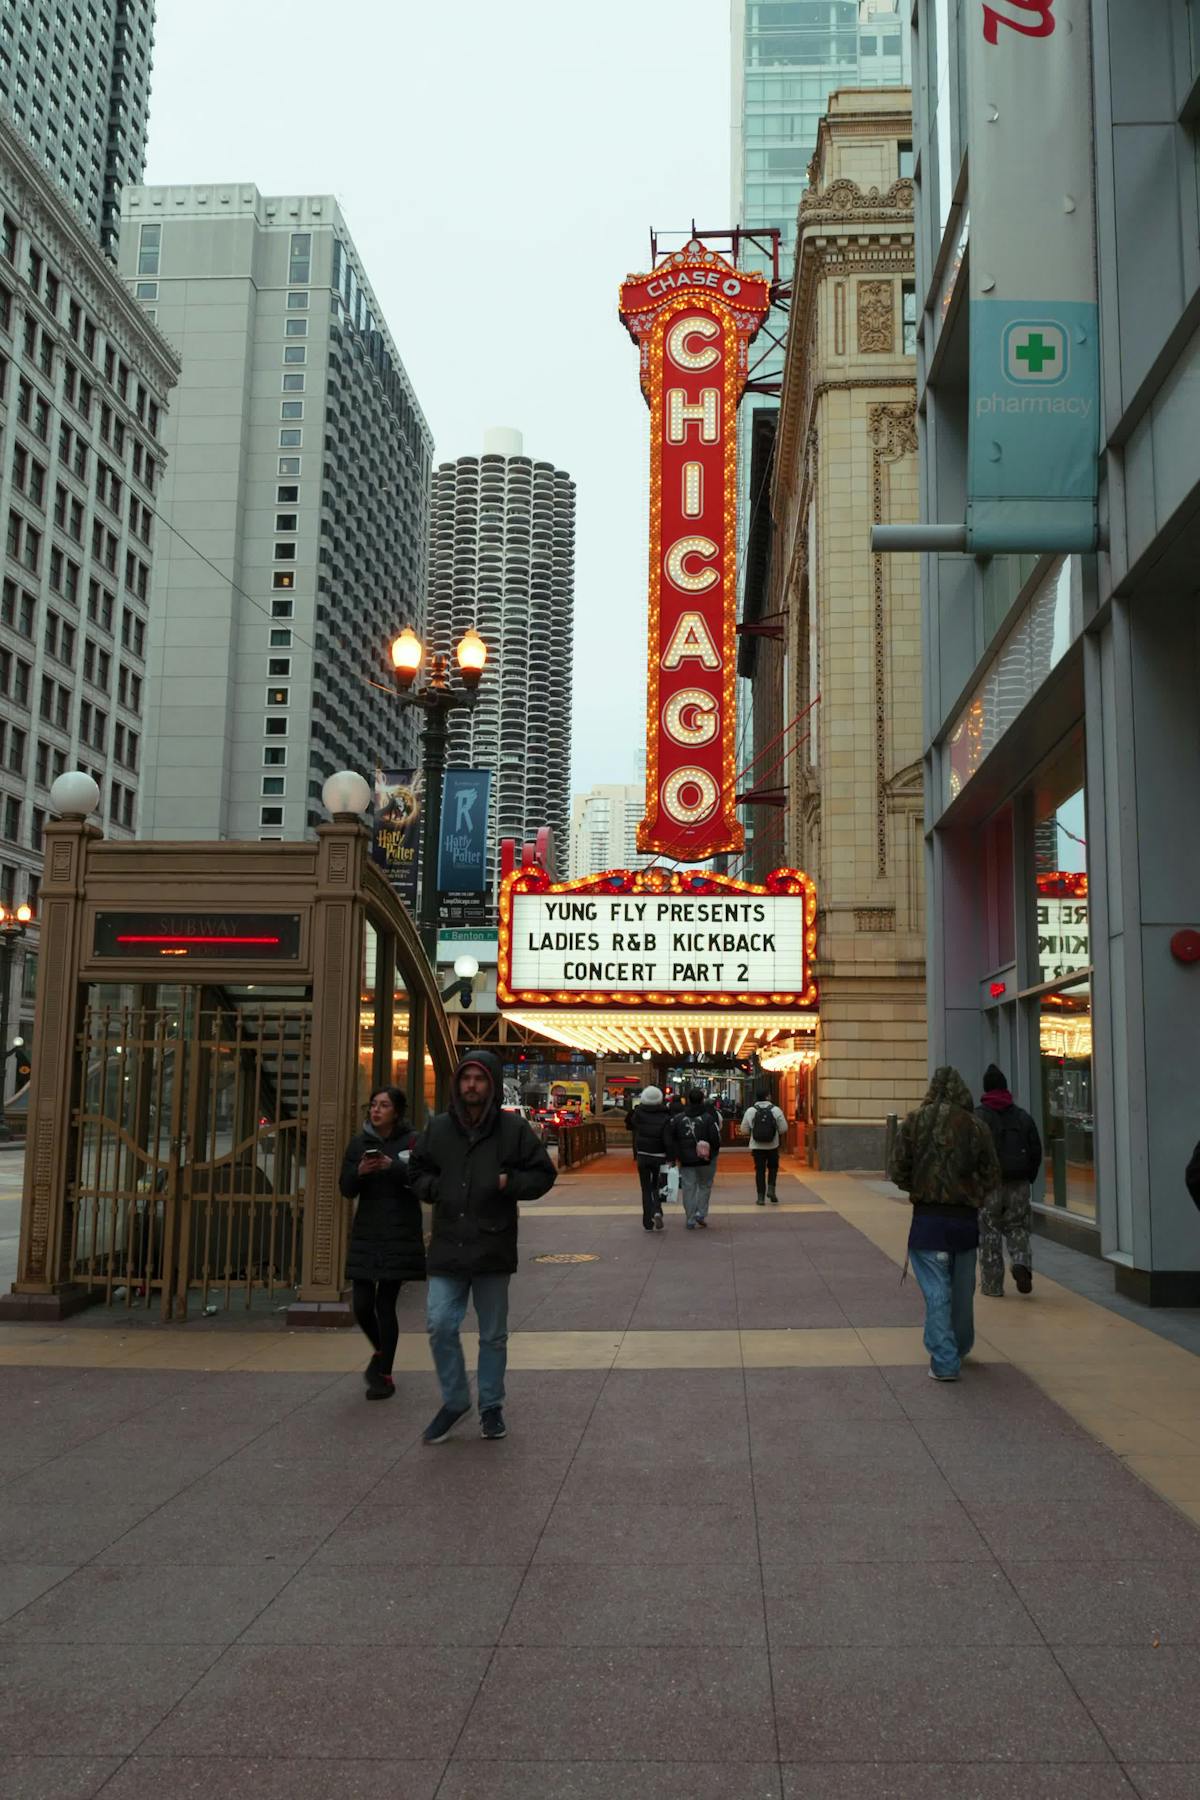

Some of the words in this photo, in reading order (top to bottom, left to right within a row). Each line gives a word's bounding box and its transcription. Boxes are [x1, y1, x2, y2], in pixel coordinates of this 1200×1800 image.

[646, 271, 721, 298] CHASE
[976, 392, 1092, 418] pharmacy
[660, 316, 722, 827] CHICAGO
[376, 829, 406, 848] Harry
[444, 834, 472, 852] Harry
[386, 845, 415, 864] Potter
[453, 848, 481, 864] Potter
[545, 902, 598, 921] YUNG
[610, 903, 647, 921] FLY
[657, 904, 765, 923] PRESENTS
[160, 917, 241, 936] SUBWAY
[451, 931, 484, 940] Benton
[529, 932, 599, 951] LADIES
[612, 933, 657, 951] R&B
[673, 933, 776, 953] KICKBACK
[563, 962, 657, 981] CONCERT
[672, 963, 724, 982] PART
[737, 963, 749, 982] 2
